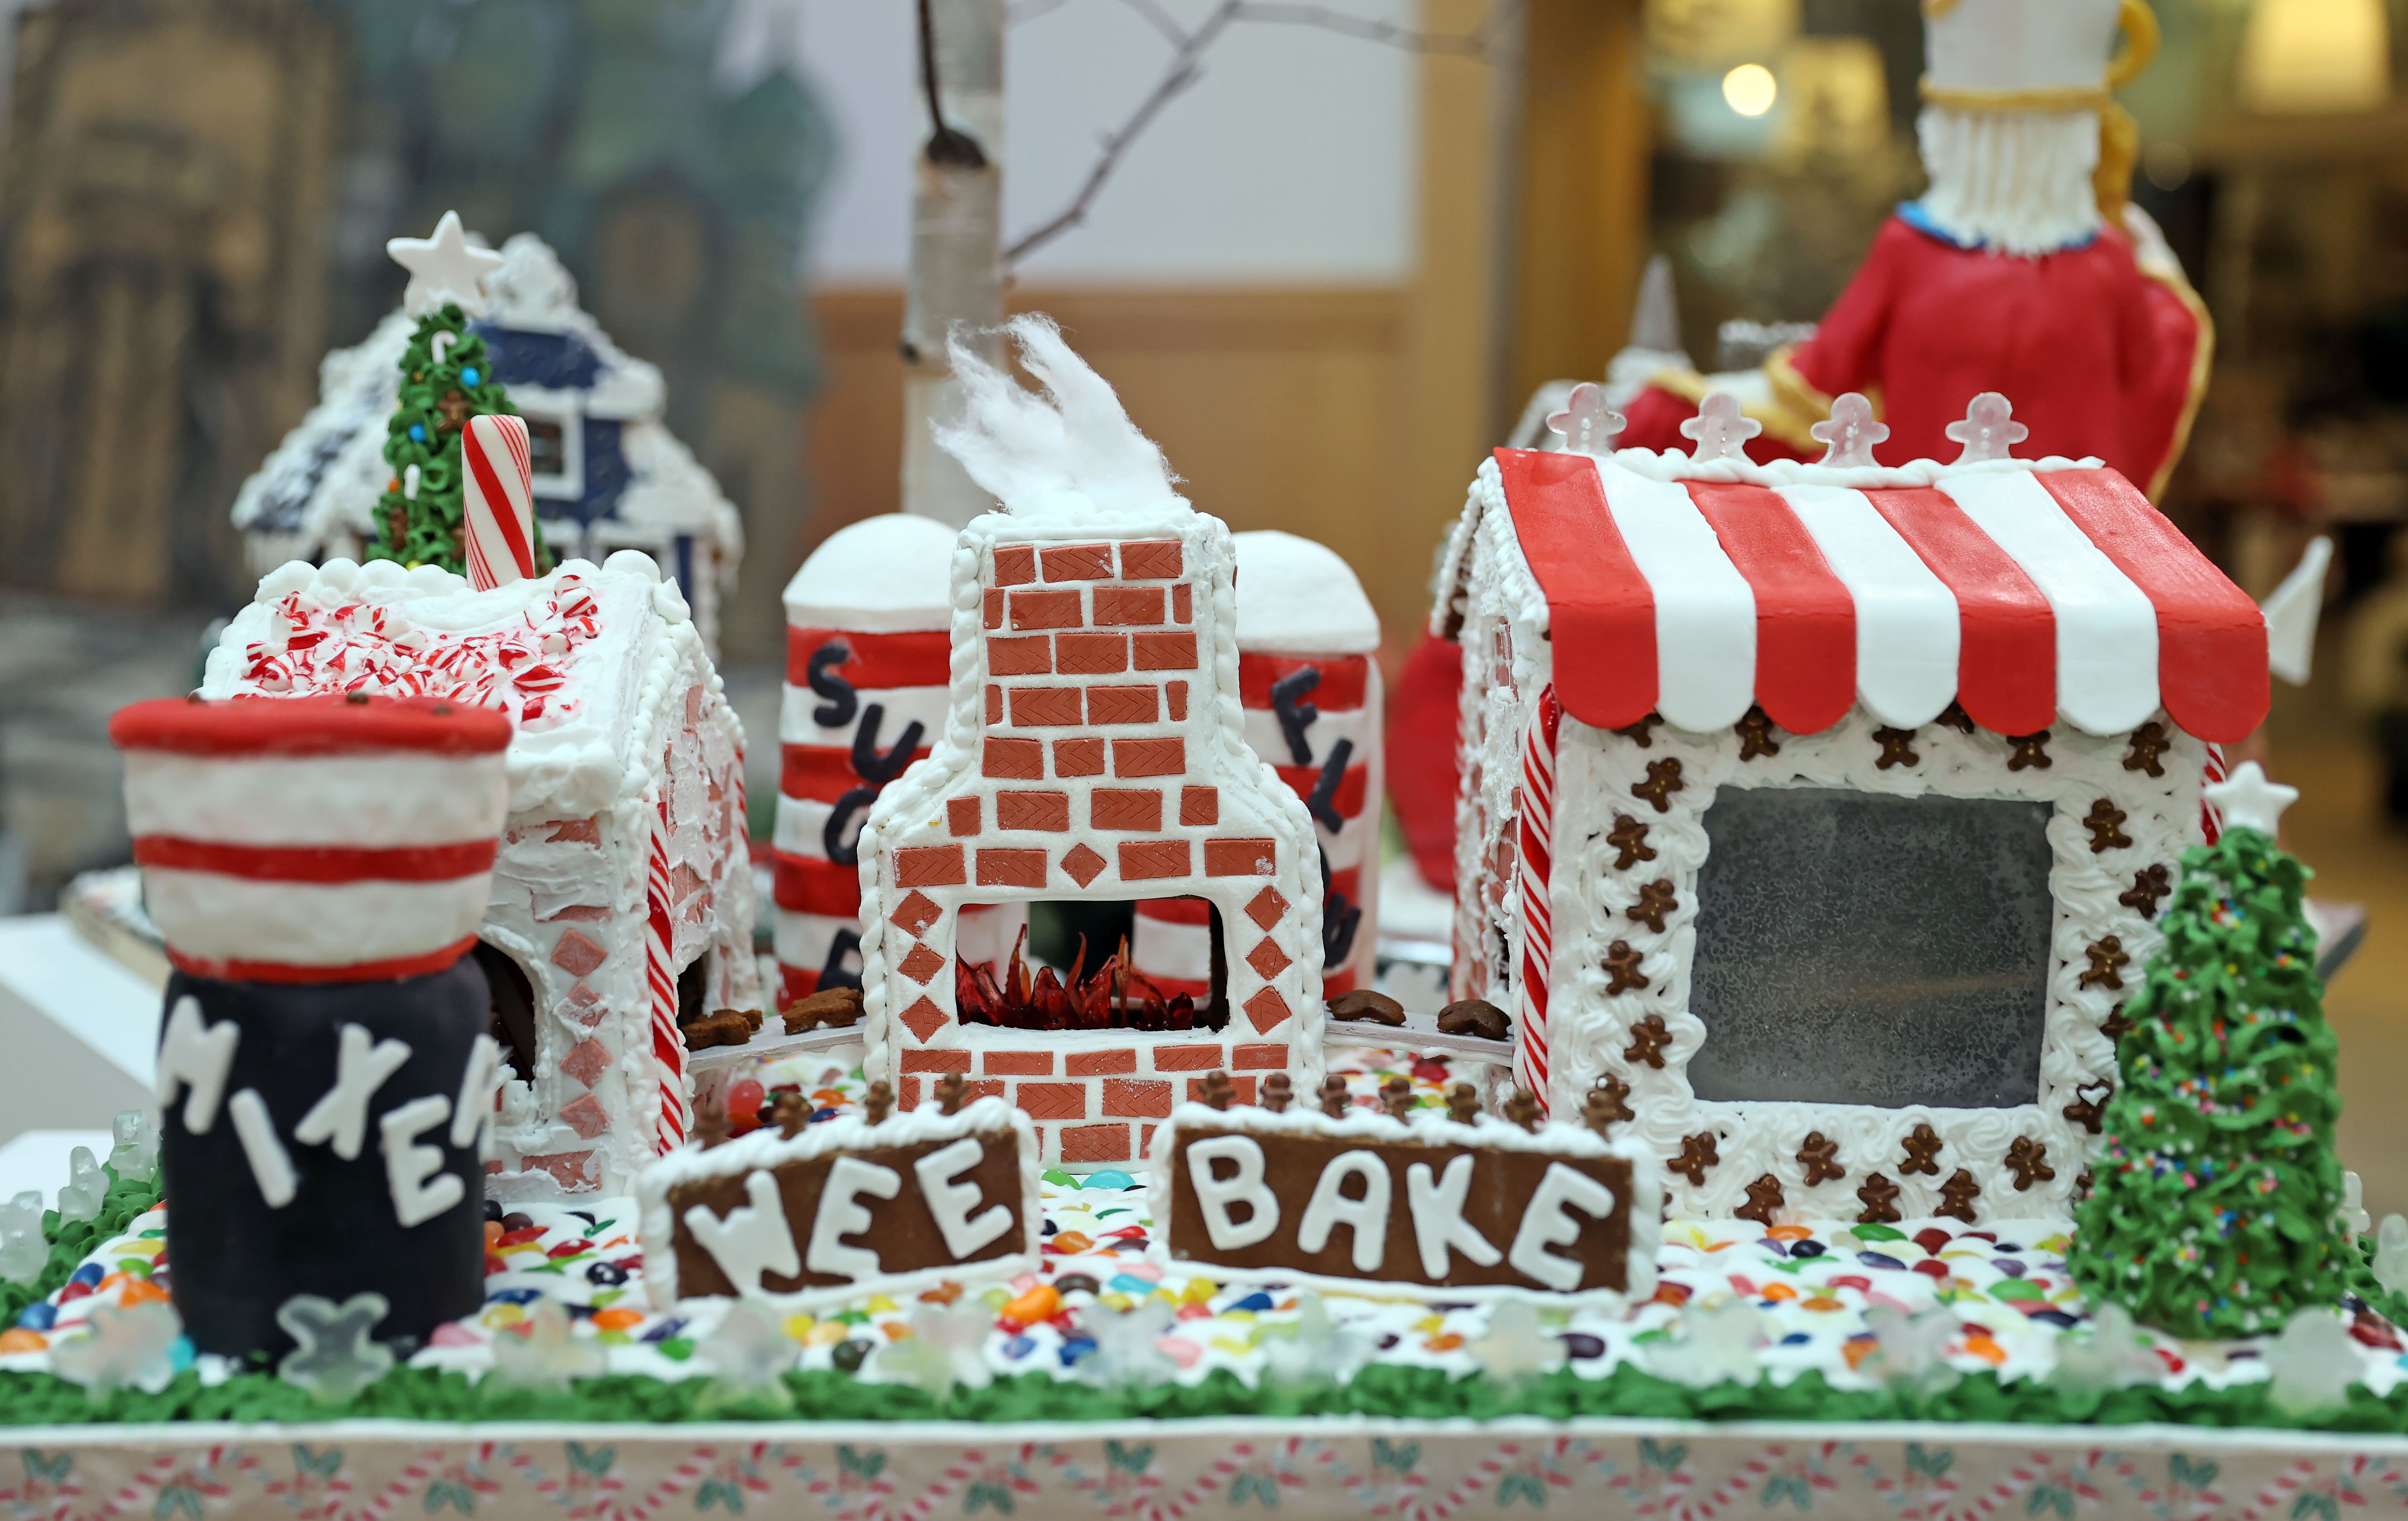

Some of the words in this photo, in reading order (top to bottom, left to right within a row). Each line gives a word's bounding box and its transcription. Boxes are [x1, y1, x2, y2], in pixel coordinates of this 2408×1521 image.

[156, 995, 499, 1228] MIXER
[683, 1137, 1015, 1296] WEE
[1186, 1135, 1615, 1292] BAKE
